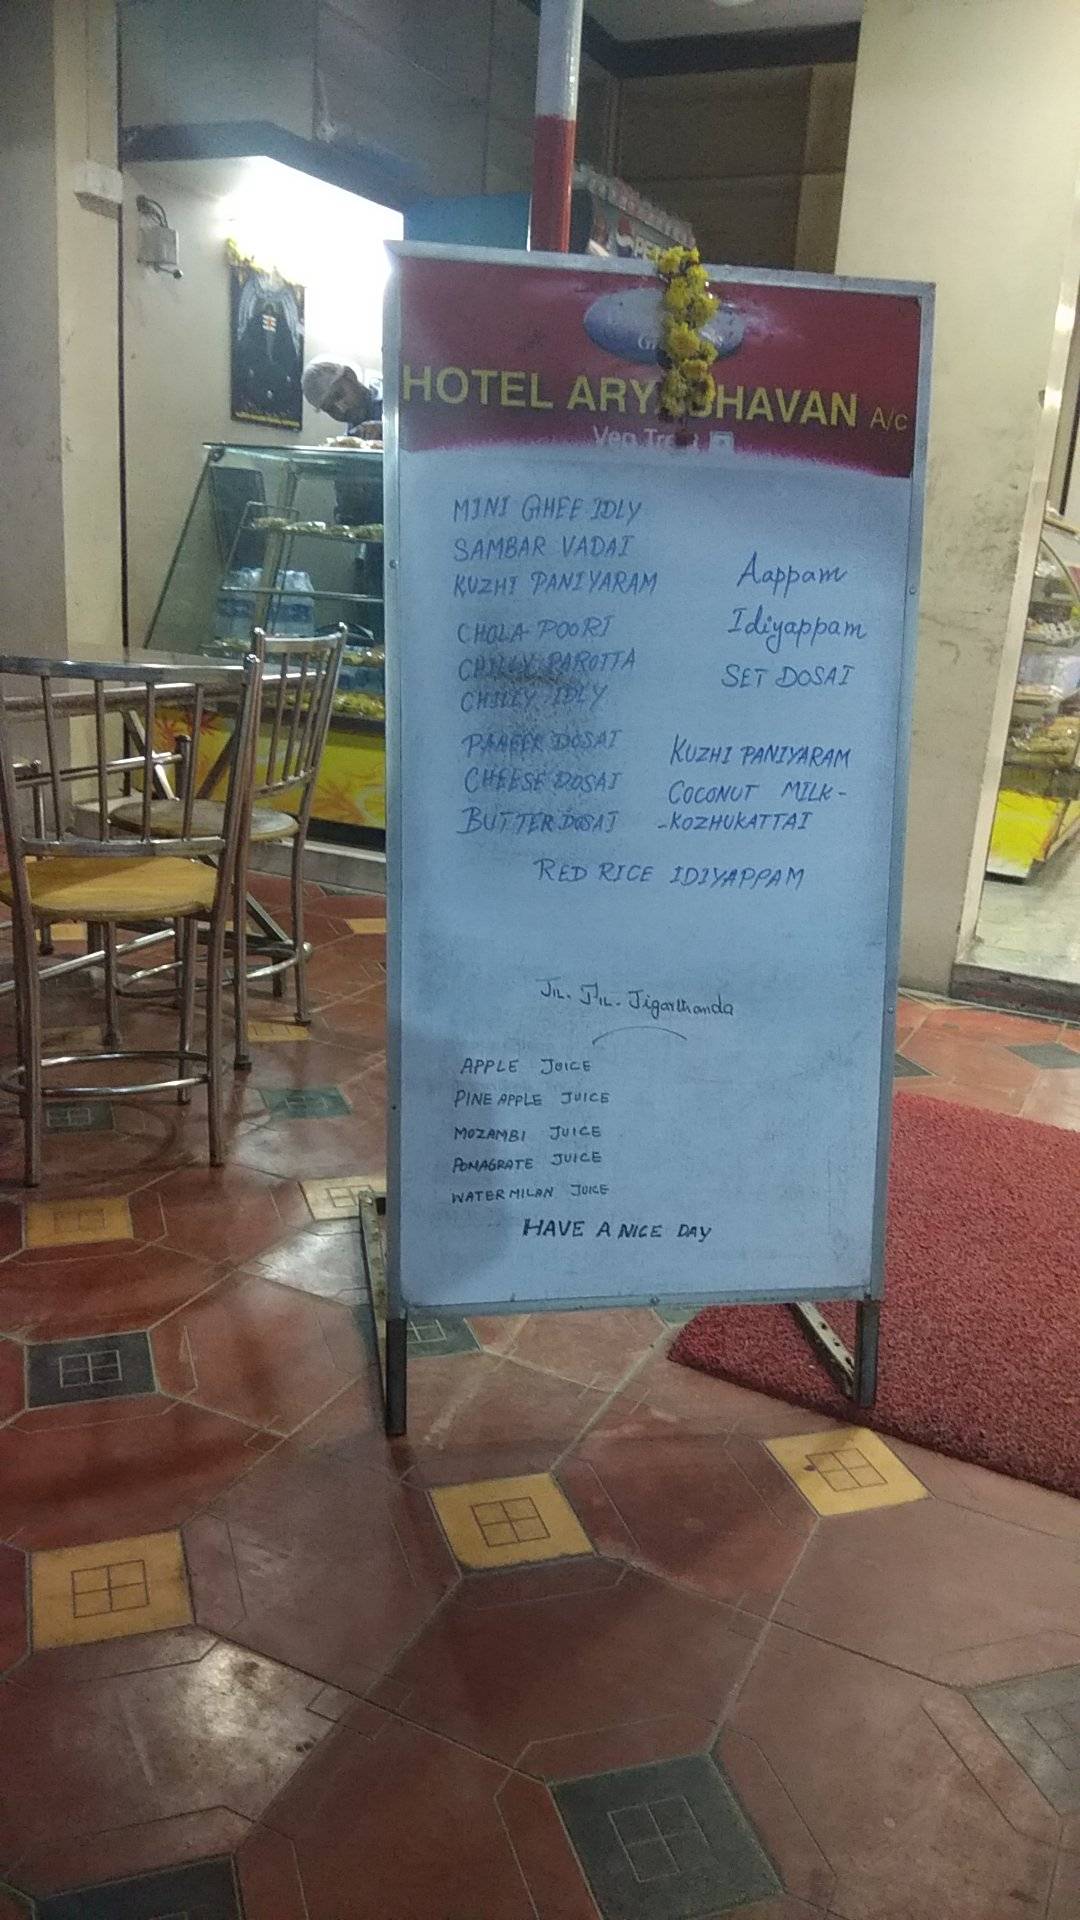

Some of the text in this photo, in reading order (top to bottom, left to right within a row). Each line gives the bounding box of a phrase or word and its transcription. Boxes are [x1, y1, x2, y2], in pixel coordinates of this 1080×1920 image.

[402, 365, 553, 411] HOTEL
[453, 493, 642, 526] MINI GHEE IDLY
[454, 535, 635, 562] SAMBAR VADAI
[454, 570, 658, 597] KUZHI PANIYARAM
[736, 551, 848, 599] Aappam
[456, 614, 615, 644] CHOLA POORI
[727, 604, 867, 654] Idiyappam
[721, 664, 855, 688] SET DOSAI
[551, 729, 623, 751] DOSAI
[670, 733, 852, 767] KUZHI PANIYARAM
[464, 766, 623, 793] CHEESE DOSAI
[668, 779, 760, 804] COCONUT
[456, 806, 620, 835] BUTTER DOSAI
[533, 858, 805, 891] RED RICE IDIYAPPAM
[460, 1057, 519, 1075] APPLE
[560, 1091, 611, 1105] JUICE
[453, 1125, 602, 1143] MOZAMBI JUICE
[550, 1151, 602, 1167] JUICE
[570, 1183, 610, 1197] JUICE
[522, 1217, 586, 1239] HAVE
[595, 1220, 611, 1238] A
[617, 1222, 664, 1240] NICE
